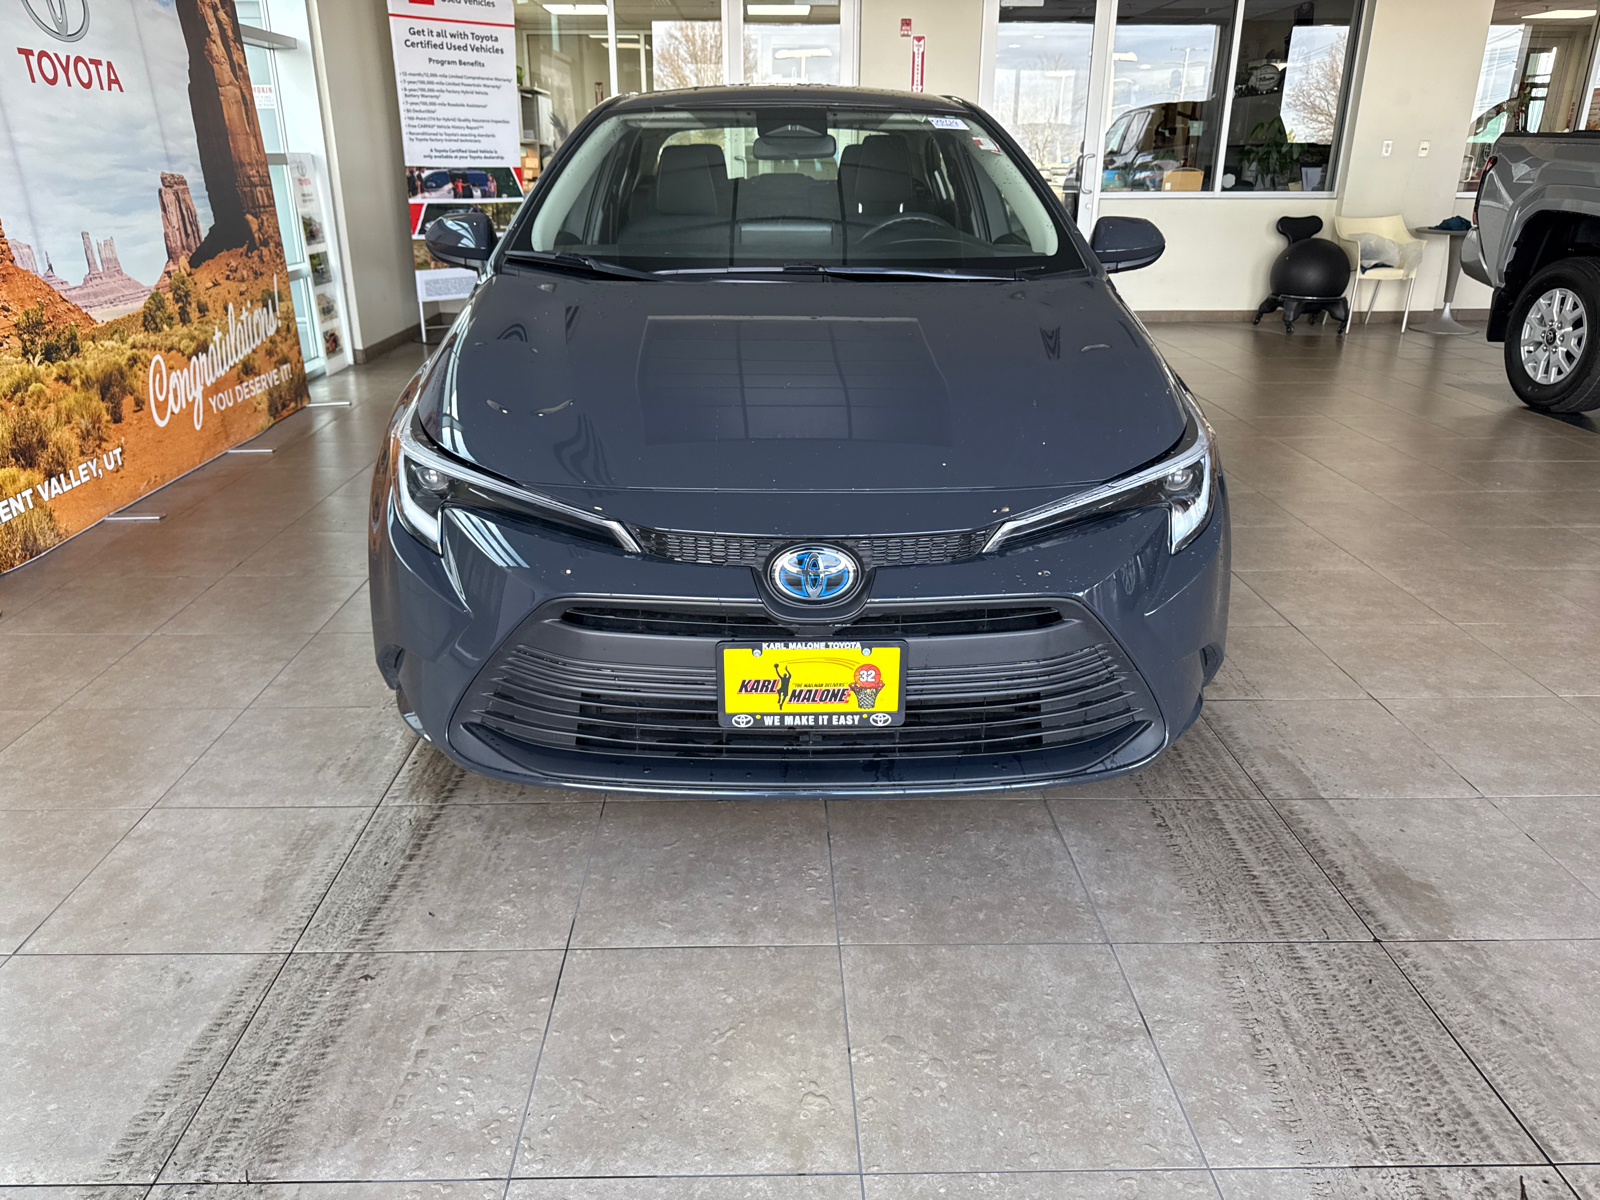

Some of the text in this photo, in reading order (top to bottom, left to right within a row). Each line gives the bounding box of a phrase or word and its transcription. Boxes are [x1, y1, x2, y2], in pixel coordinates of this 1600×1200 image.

[408, 27, 499, 43] Get it all with Toyota
[404, 39, 504, 55] Certified Used Vehicles
[17, 47, 124, 93] TOYOTA
[428, 57, 486, 68] Program Benefits
[148, 273, 282, 431] Congratulations!
[208, 363, 292, 414] YOU DESERVE IT!
[0, 447, 122, 524] ENT VALLEY, UT
[762, 642, 862, 650] KARL MALONE TOYOTA
[859, 670, 876, 682] 32
[737, 679, 780, 694] KARL
[787, 688, 851, 704] MALONE
[763, 714, 861, 726] WE MAKE IT EASY
